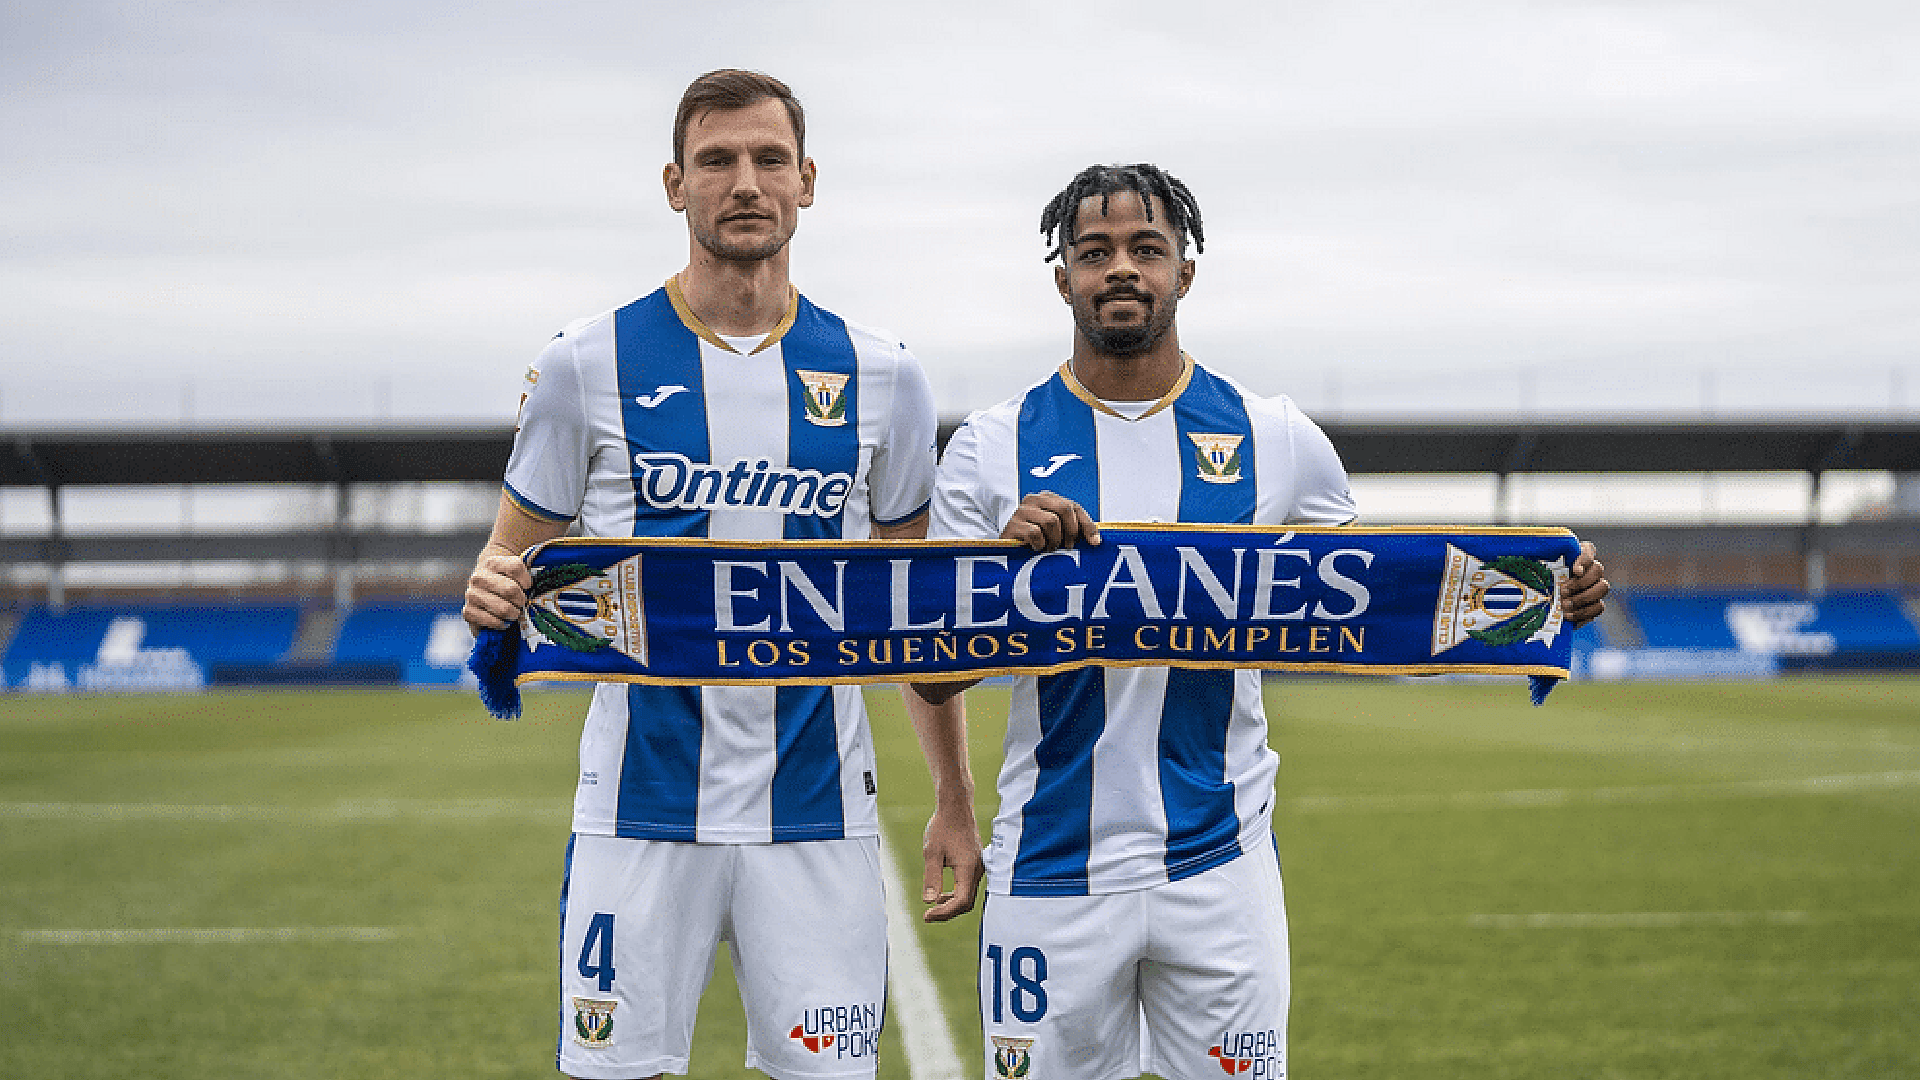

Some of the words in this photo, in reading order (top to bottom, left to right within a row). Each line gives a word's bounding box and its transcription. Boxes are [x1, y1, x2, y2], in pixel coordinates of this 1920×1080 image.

[635, 453, 853, 518] Ontime
[712, 560, 849, 632] EN
[889, 532, 1375, 631] LEGANÉS
[717, 640, 811, 667] LOS
[838, 631, 1029, 666] SUEÑOS
[1055, 626, 1106, 652] SE
[1134, 625, 1366, 653] CUMPLEN
[577, 912, 616, 992] 4
[987, 944, 1048, 1024] 18
[804, 1003, 876, 1034] URBAN
[1223, 1030, 1283, 1057] URBA
